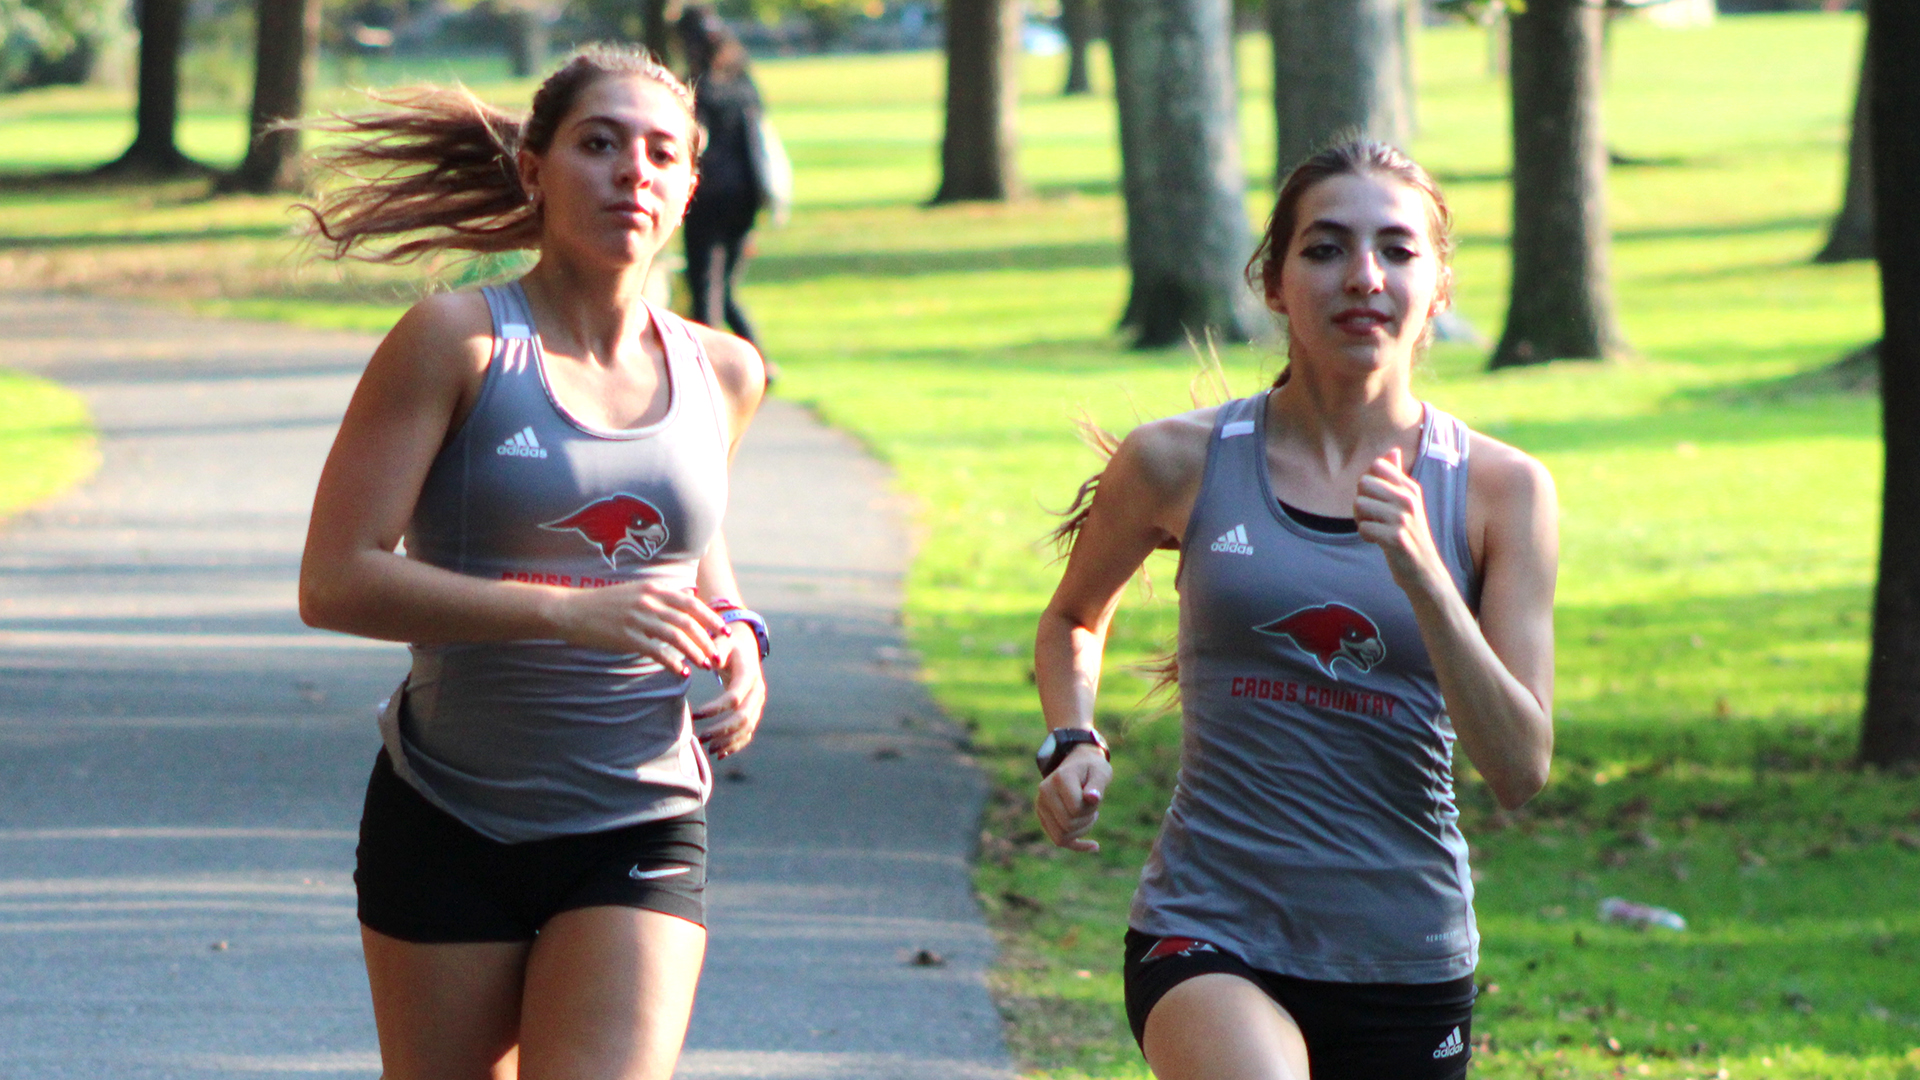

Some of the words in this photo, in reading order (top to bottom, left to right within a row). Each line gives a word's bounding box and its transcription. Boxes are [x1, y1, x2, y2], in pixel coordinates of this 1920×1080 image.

[496, 444, 548, 459] adidas
[1211, 541, 1254, 556] adidas
[1231, 677, 1299, 703] CROSS
[1305, 685, 1396, 717] COUNTRY
[1433, 1041, 1464, 1059] adidas
